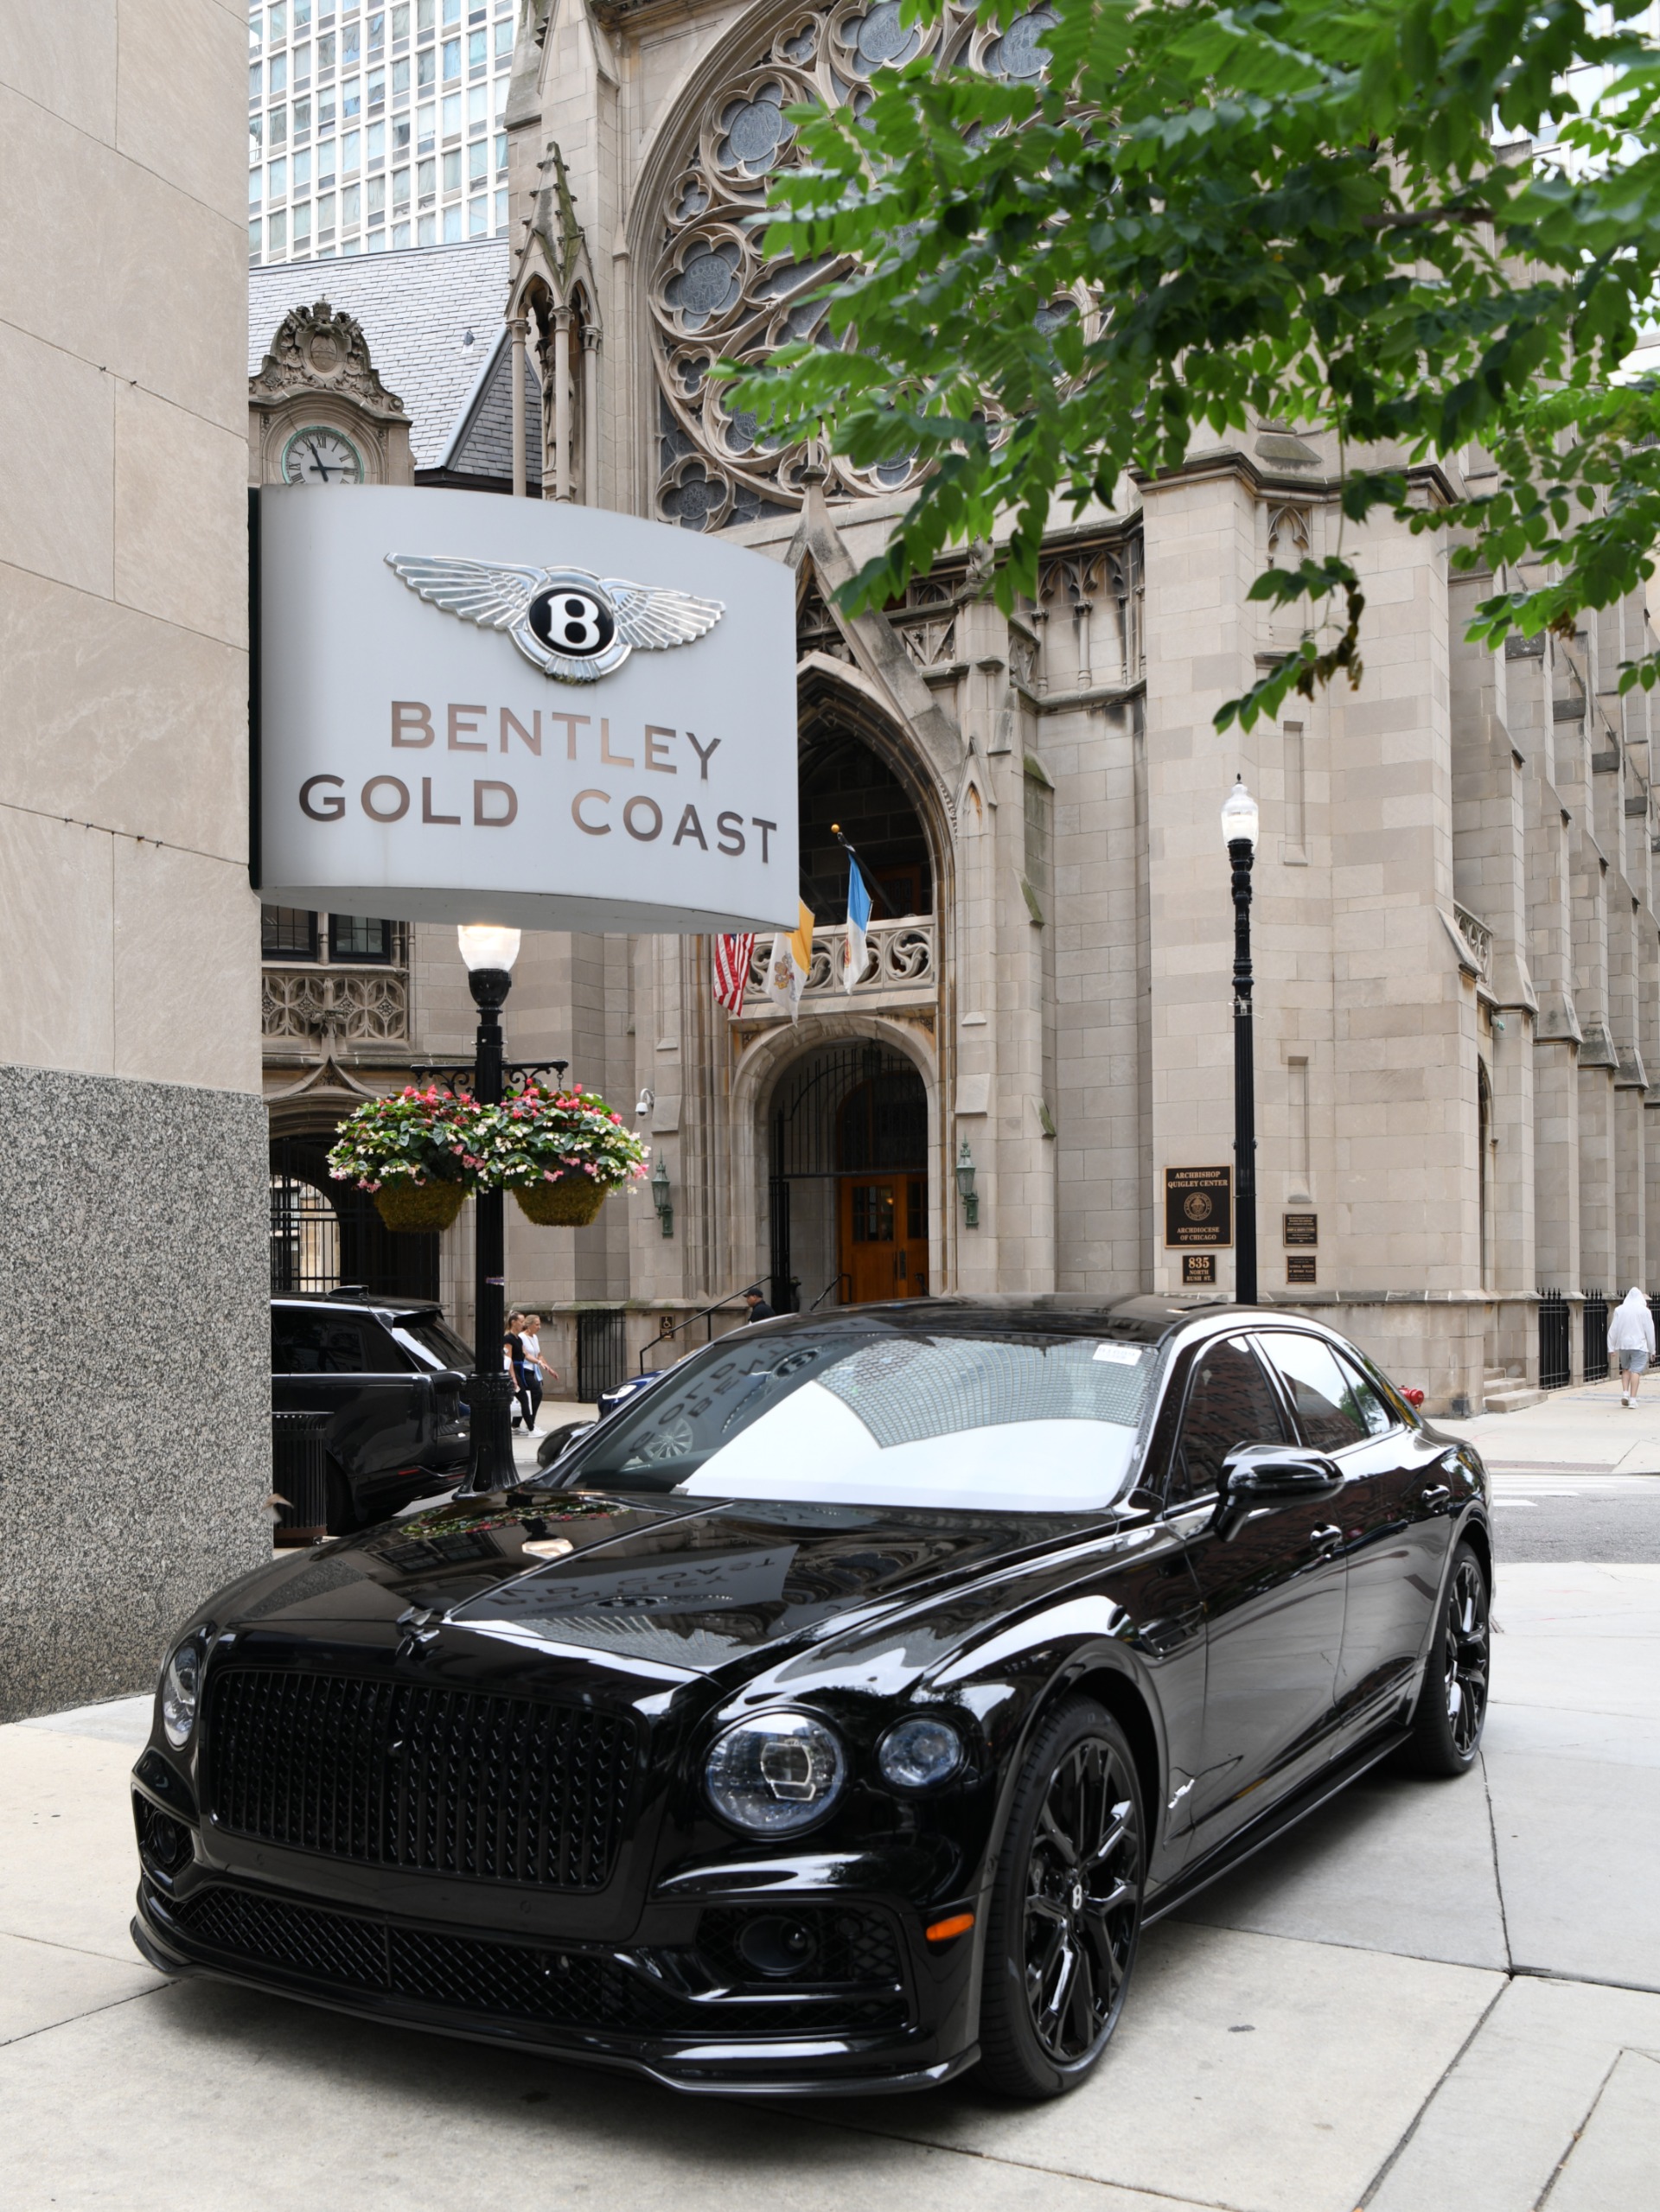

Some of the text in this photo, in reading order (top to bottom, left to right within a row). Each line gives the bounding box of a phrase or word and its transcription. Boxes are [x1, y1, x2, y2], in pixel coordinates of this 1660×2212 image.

[547, 592, 601, 650] B
[391, 701, 722, 781] BENTLEY
[298, 775, 778, 864] GOLD COAST
[1188, 1257, 1210, 1269] 835
[1073, 1884, 1082, 1909] B
